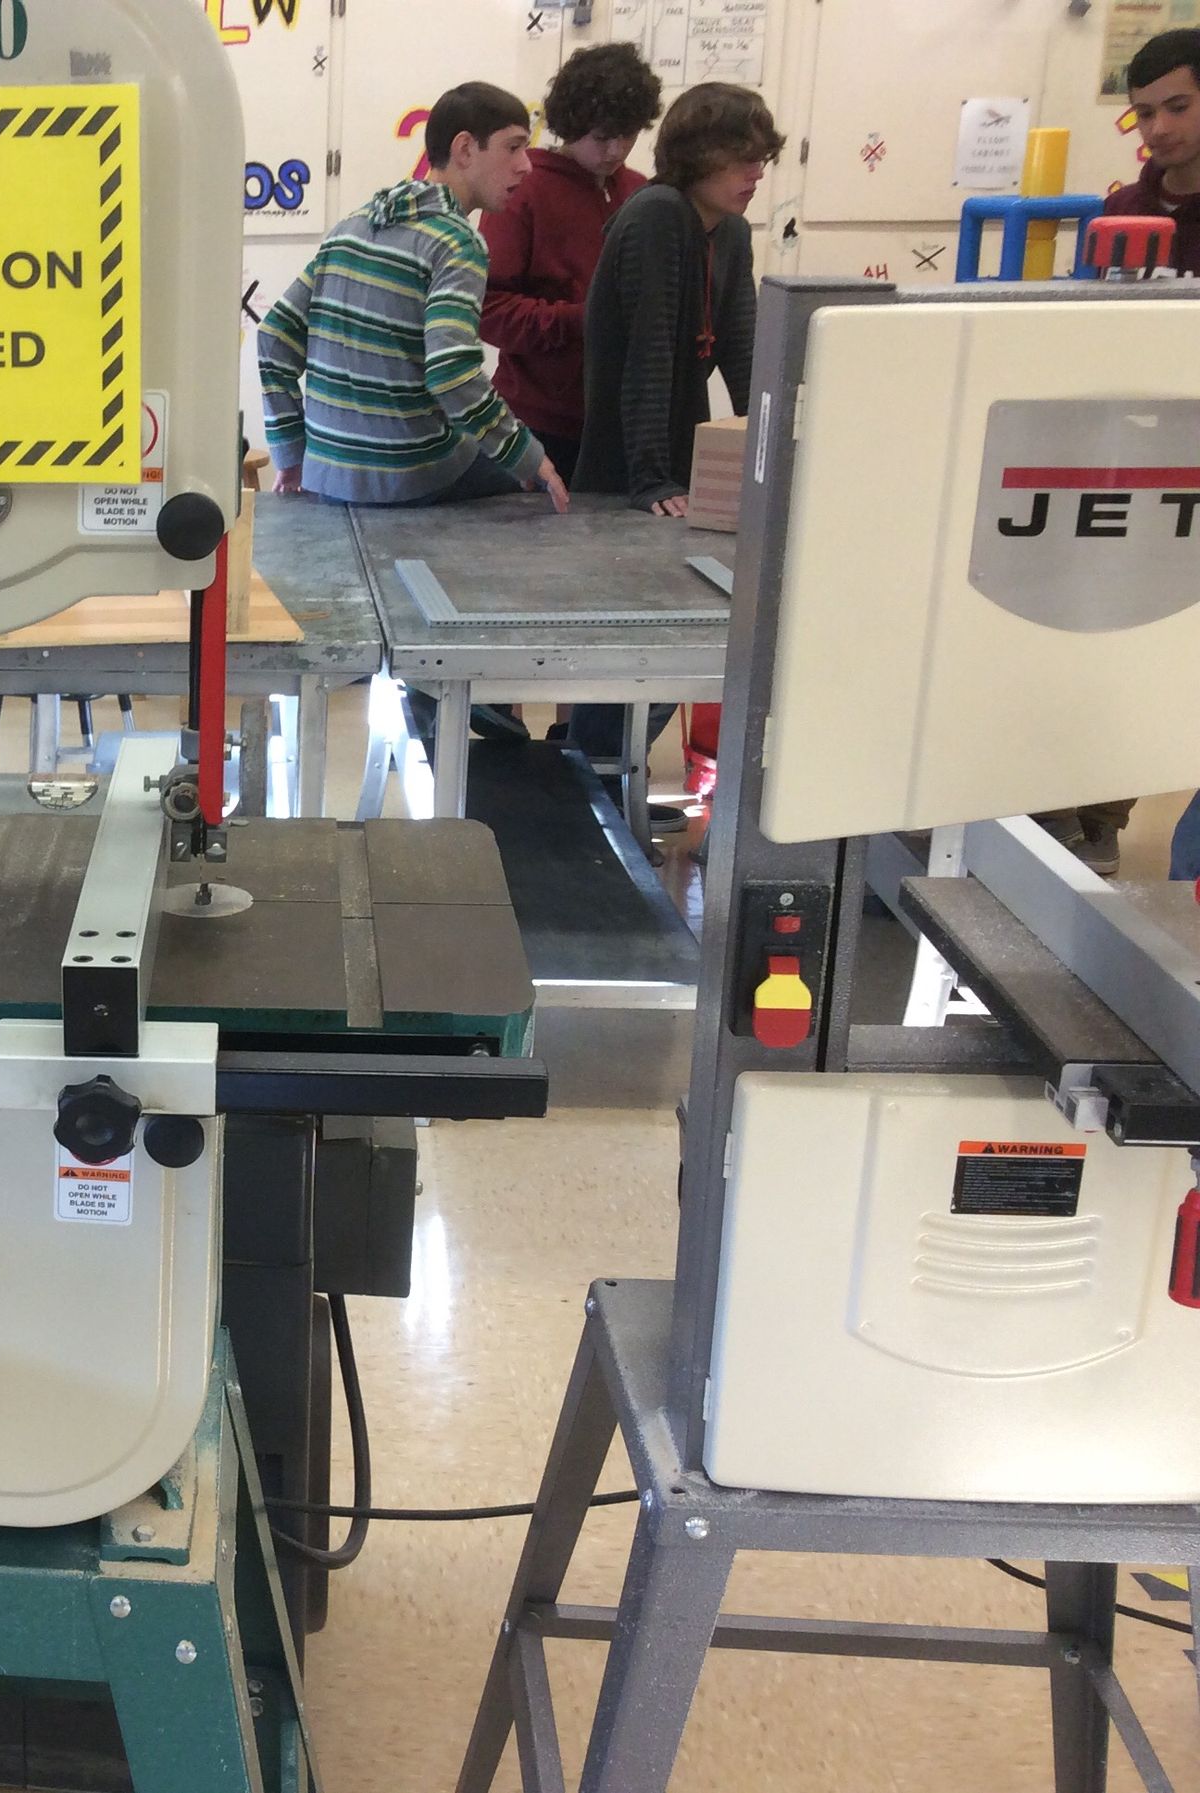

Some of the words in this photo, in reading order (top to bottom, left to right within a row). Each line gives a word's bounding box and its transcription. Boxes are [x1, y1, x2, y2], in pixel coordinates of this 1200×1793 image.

[120, 498, 148, 506] WHILE
[997, 492, 1200, 538] JET
[103, 518, 138, 526] MOTION
[998, 1144, 1064, 1155] WARNING
[76, 1208, 108, 1216] MOTION
